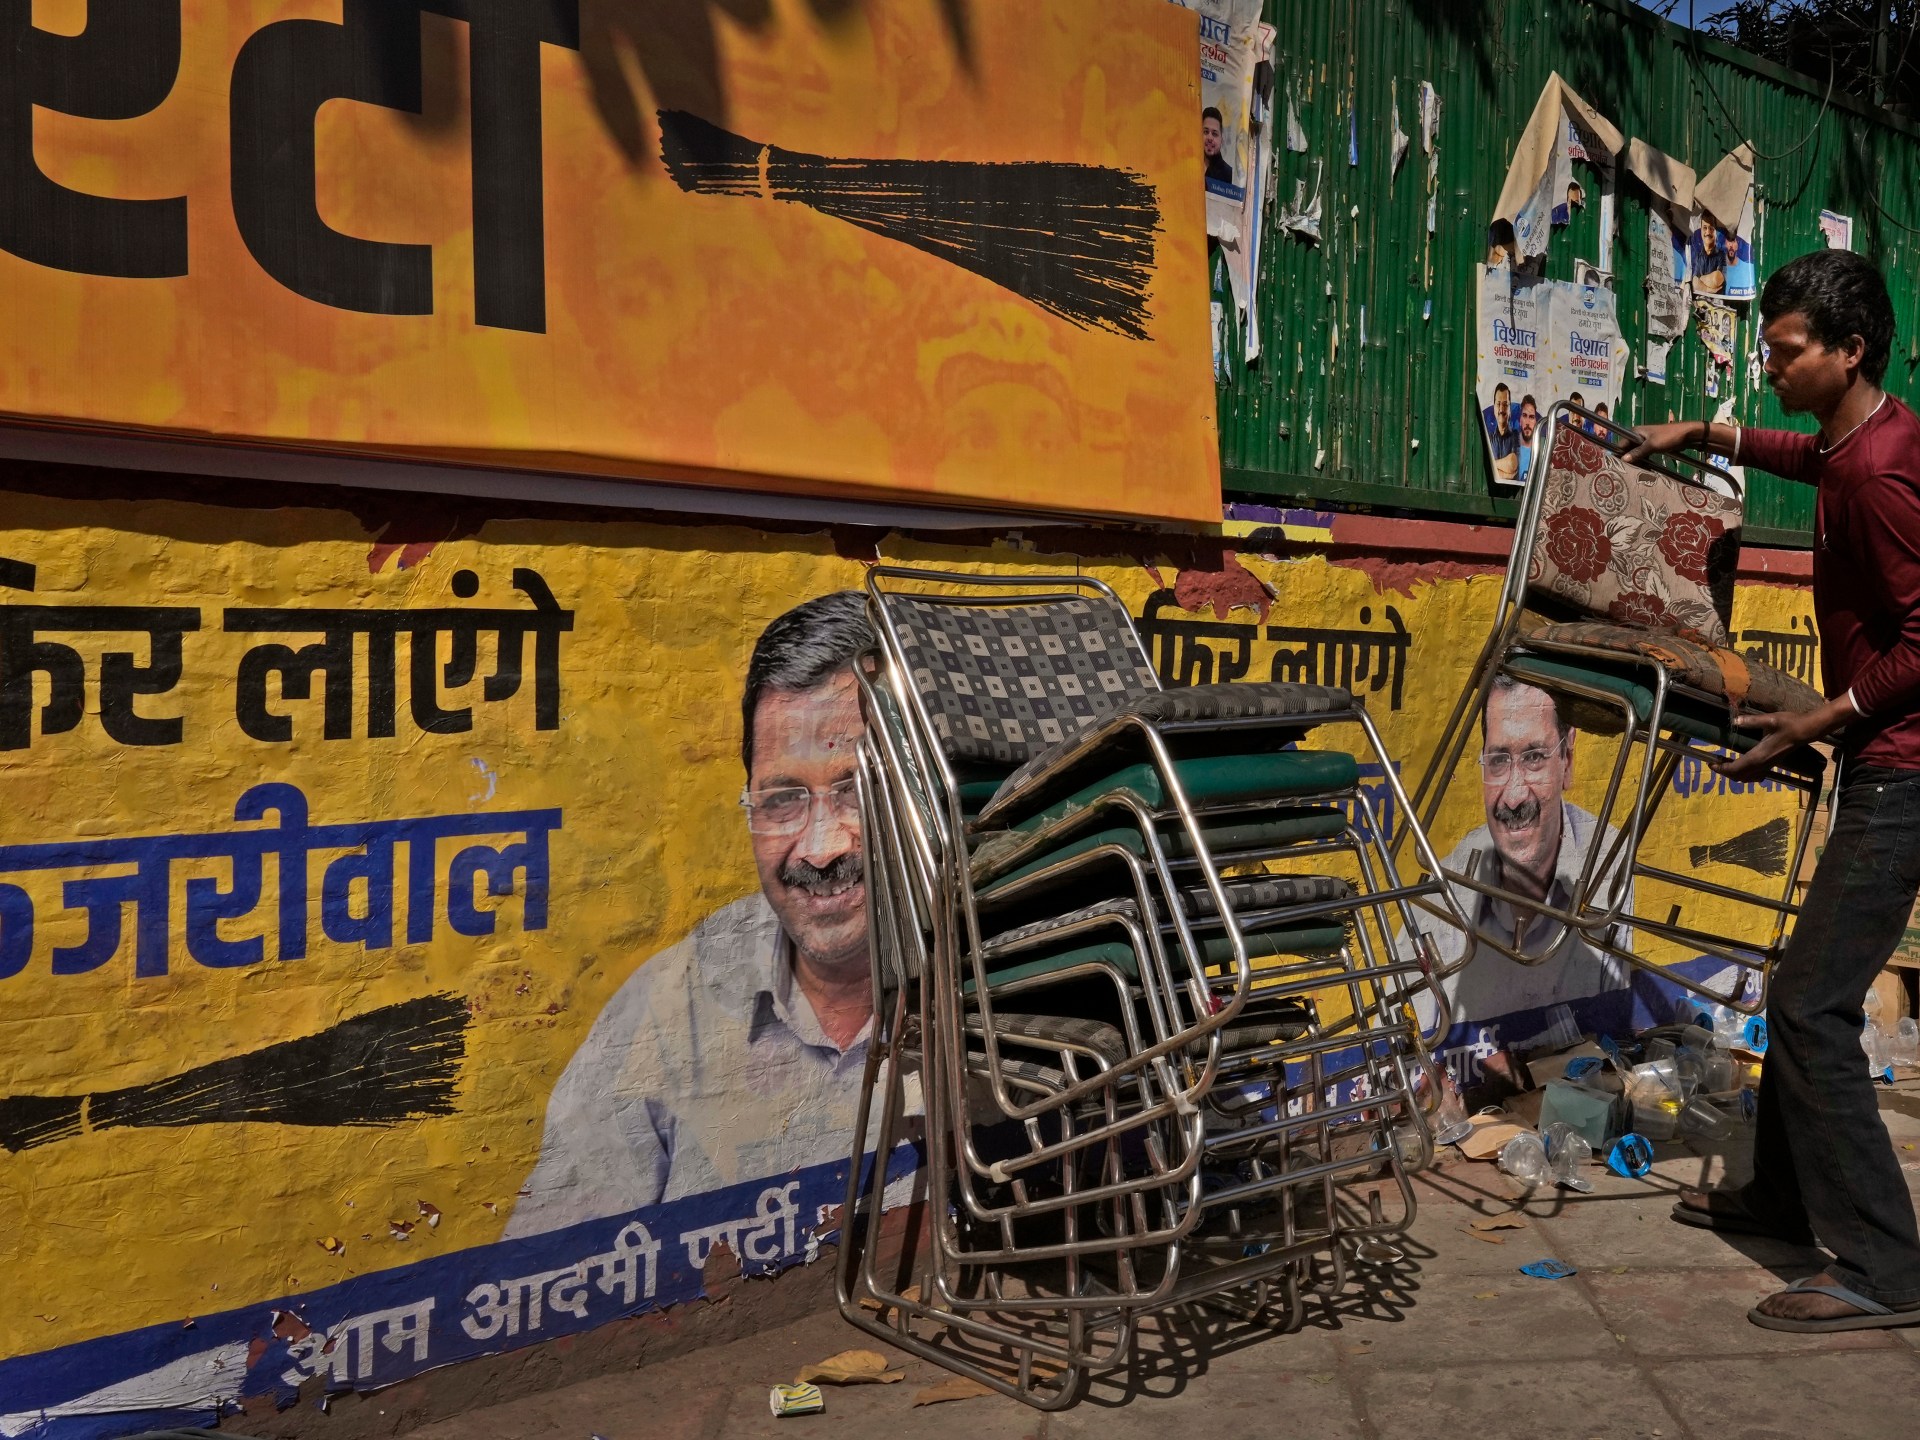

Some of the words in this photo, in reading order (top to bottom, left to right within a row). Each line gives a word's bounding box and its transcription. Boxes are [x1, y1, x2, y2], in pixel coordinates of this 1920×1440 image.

[1200, 42, 1228, 64] दर्शन
[1493, 319, 1536, 348] विशाल
[1570, 331, 1609, 357] विशाल
[222, 568, 575, 743] लाएंगे
[280, 1297, 436, 1387] आम
[460, 1221, 662, 1341] आदमी
